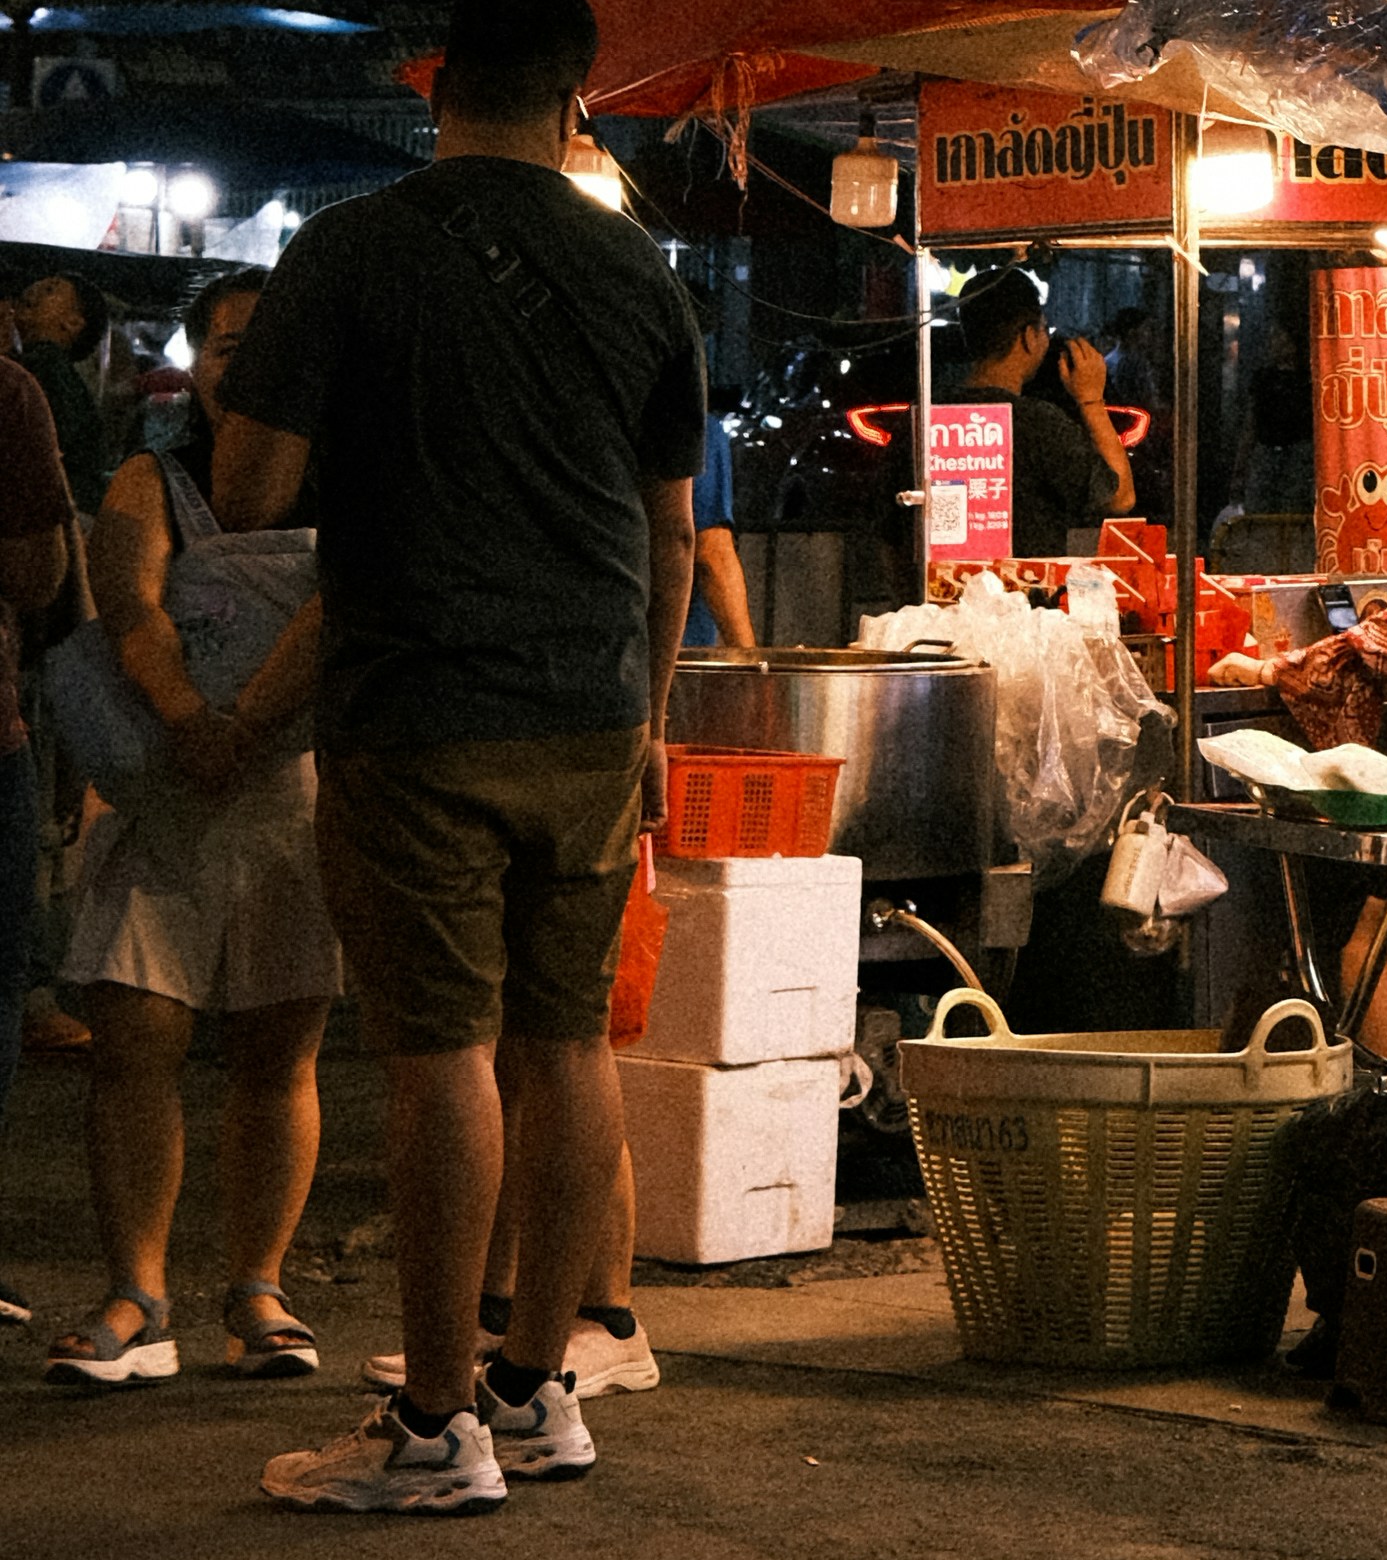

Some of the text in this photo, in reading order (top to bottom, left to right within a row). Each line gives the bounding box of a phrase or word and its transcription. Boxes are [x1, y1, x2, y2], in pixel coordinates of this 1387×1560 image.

[934, 97, 1158, 187] เกาลัดญี่ปุ่น
[930, 412, 1004, 447] กาลัด
[968, 477, 1008, 500] 栗子
